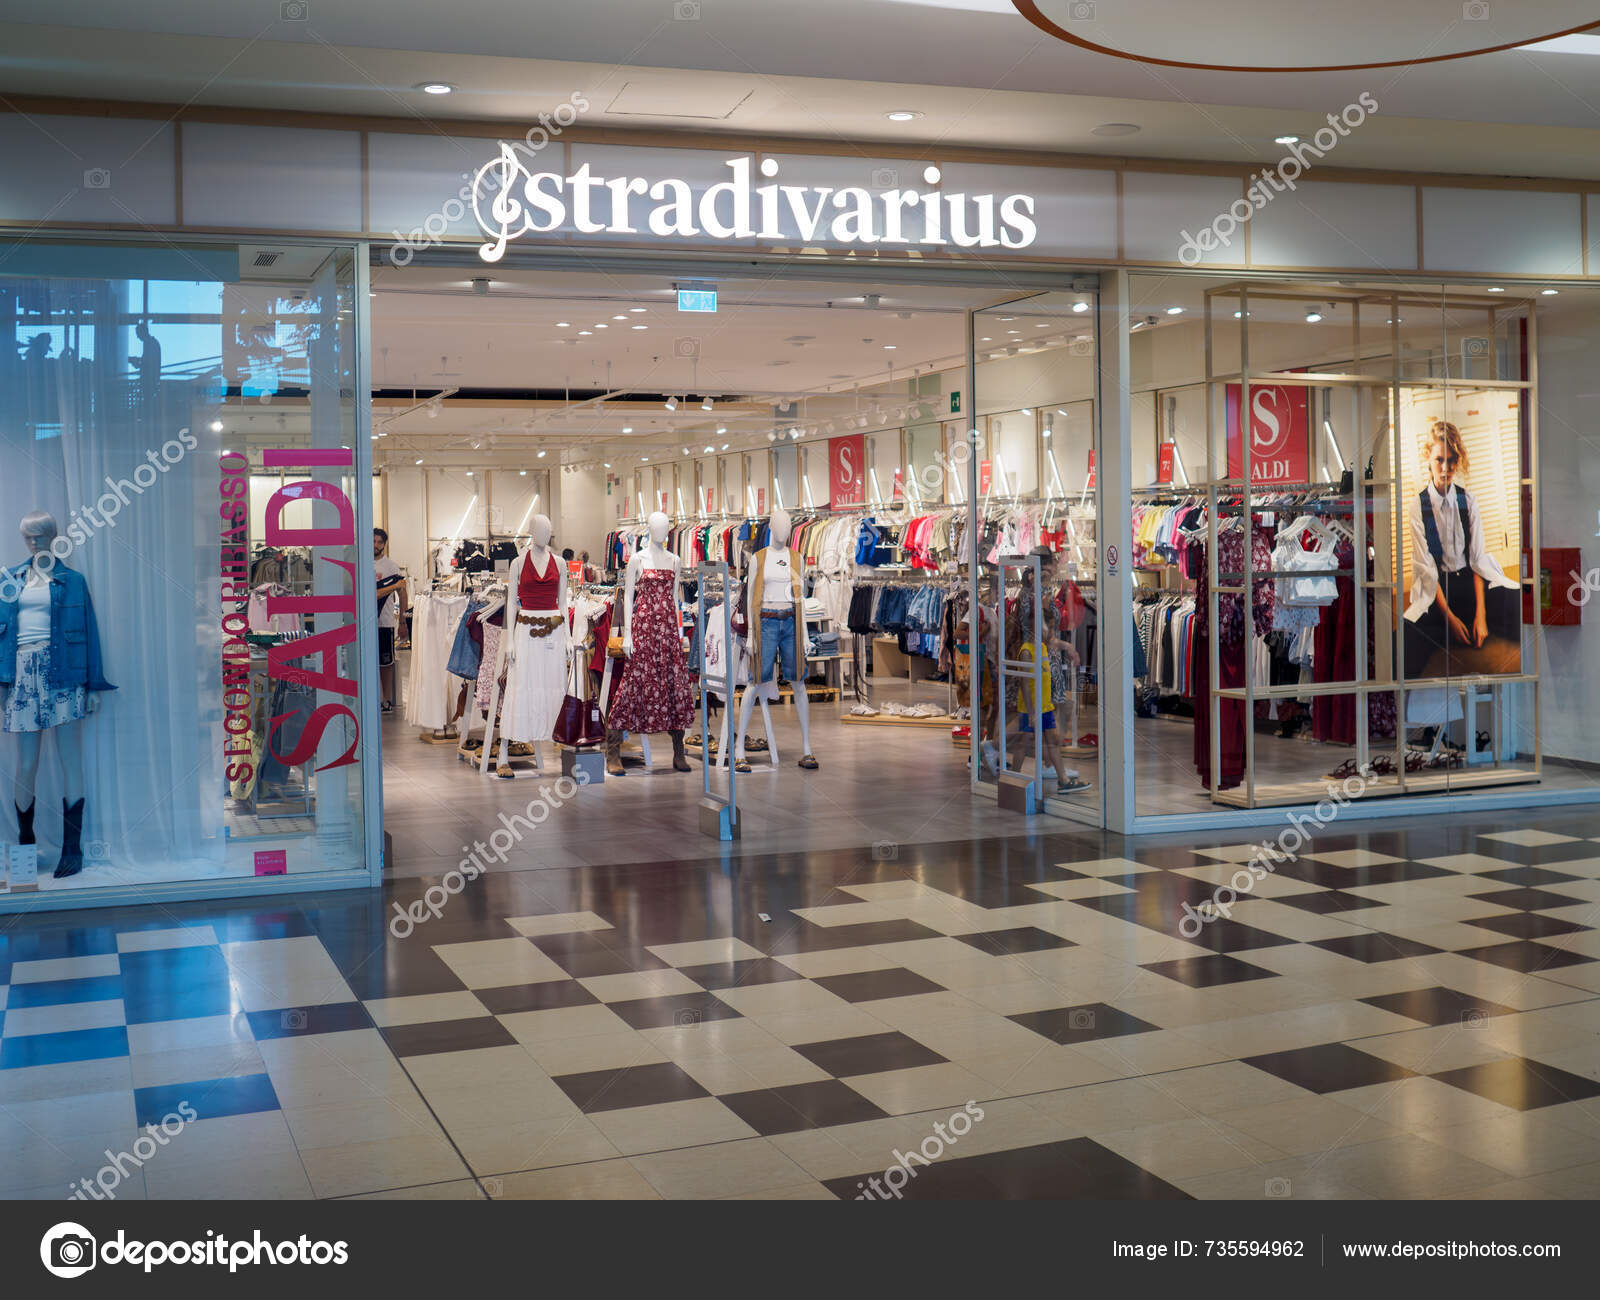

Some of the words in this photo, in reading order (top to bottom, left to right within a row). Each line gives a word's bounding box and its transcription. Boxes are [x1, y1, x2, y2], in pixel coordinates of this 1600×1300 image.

[524, 156, 1037, 249] stradivarius
[218, 451, 249, 602] RIBASSO
[1251, 459, 1290, 480] ALDI
[263, 448, 360, 773] SALDI
[221, 612, 253, 784] SECONDO
